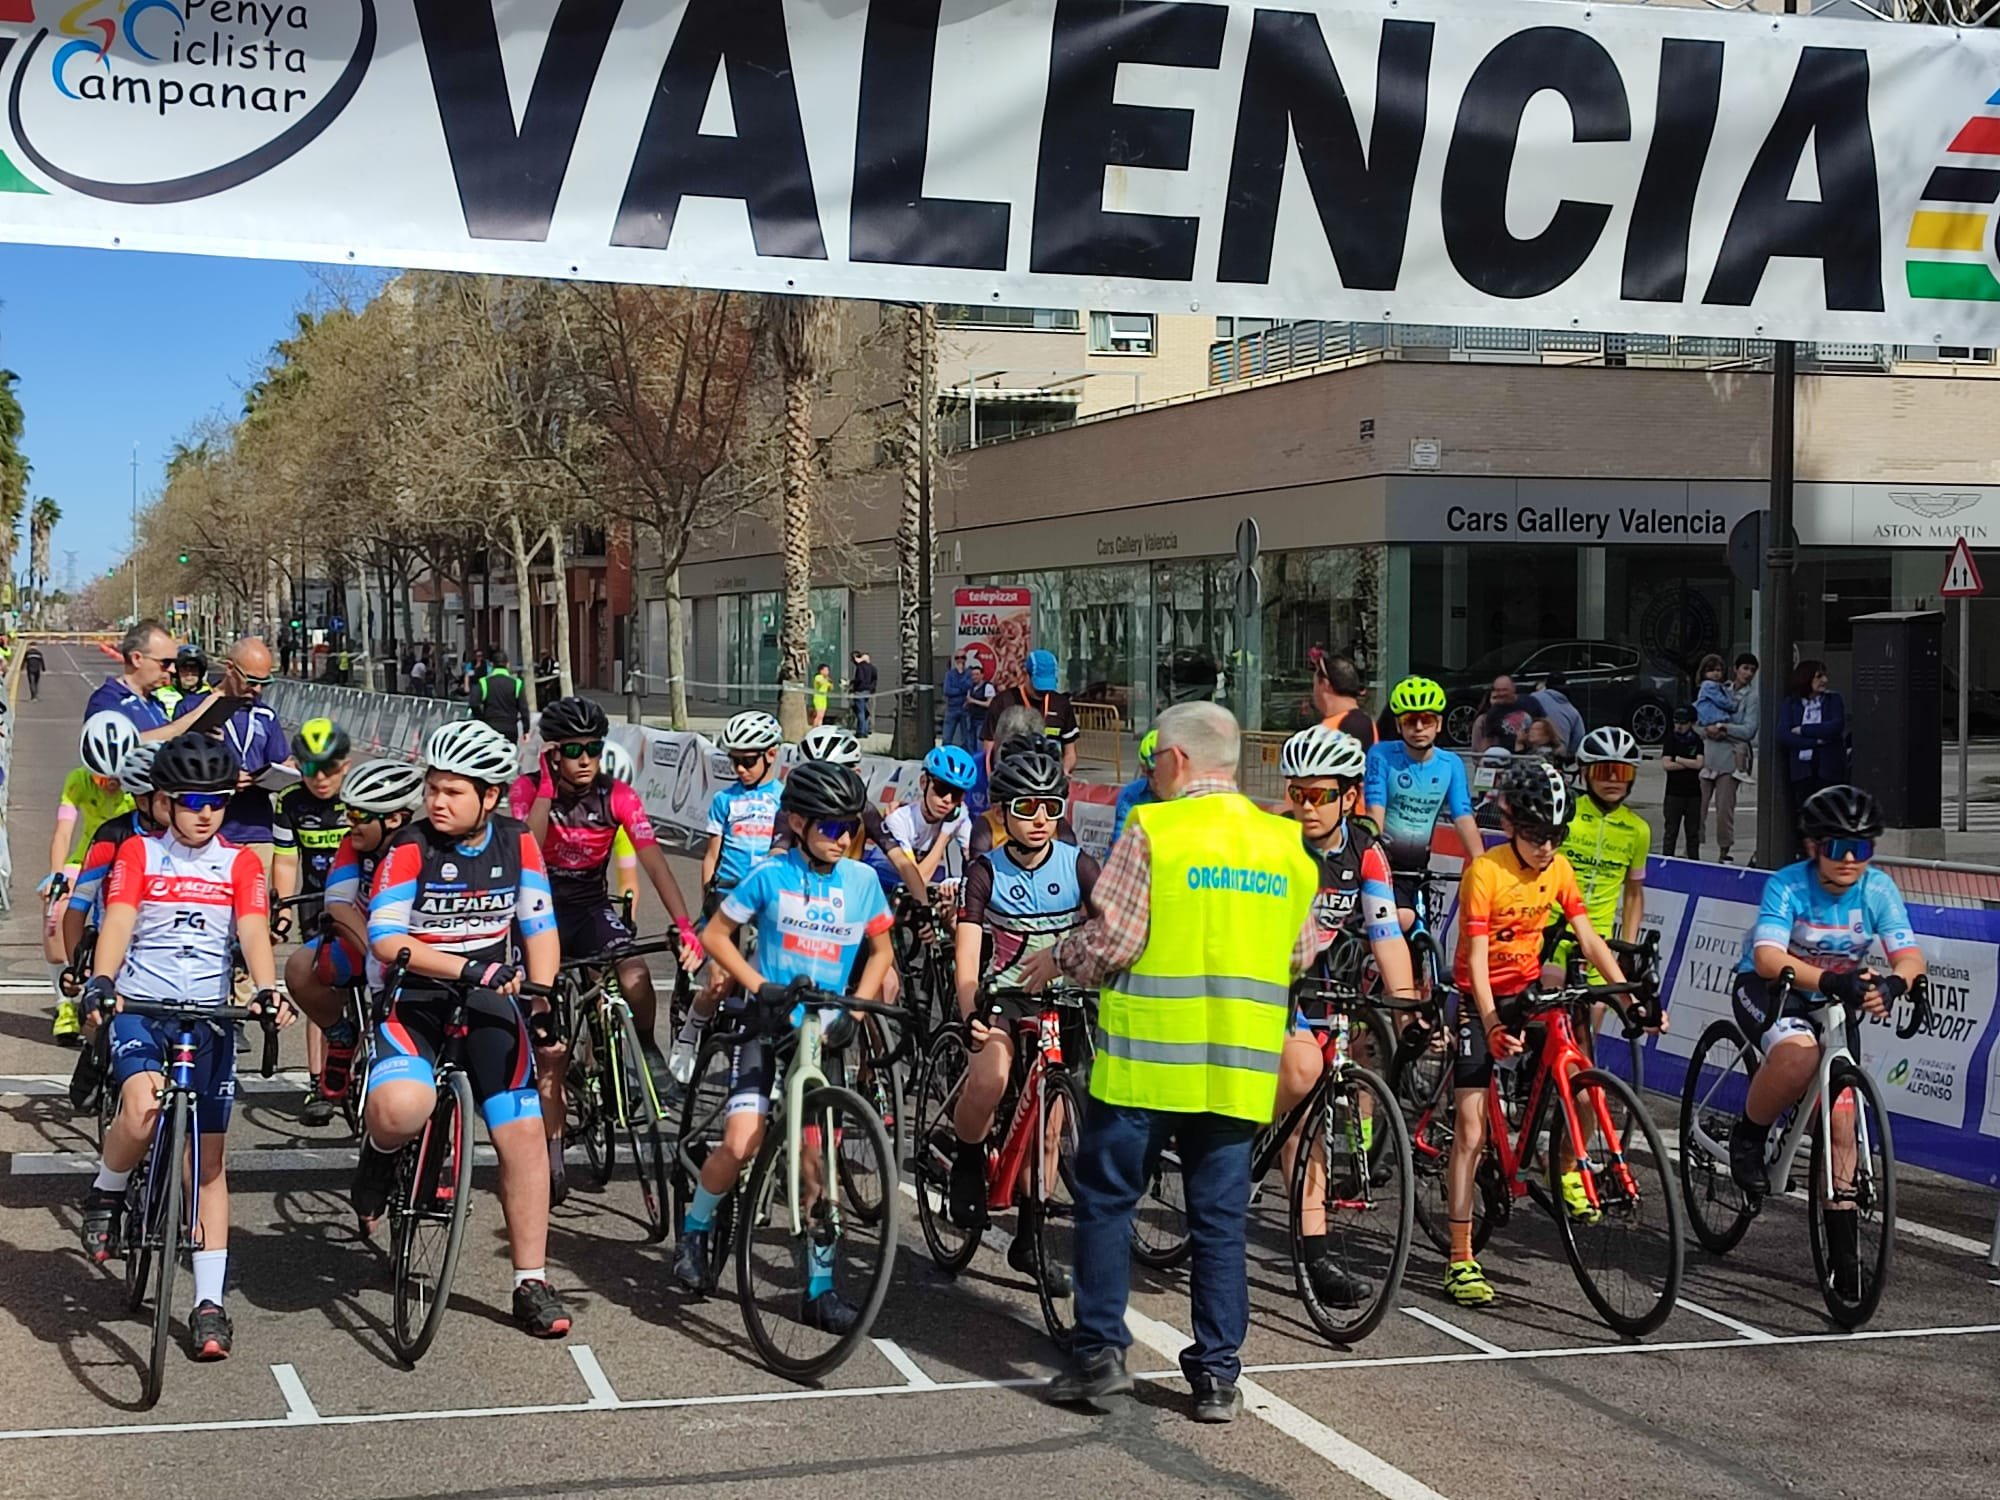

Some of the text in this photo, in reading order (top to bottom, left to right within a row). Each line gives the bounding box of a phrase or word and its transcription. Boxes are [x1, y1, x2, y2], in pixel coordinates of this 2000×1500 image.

[185, 0, 308, 36] Penya
[52, 39, 306, 115] Campanar
[414, 0, 1886, 313] VALENCIA
[1446, 506, 1726, 540] Cars Gallery Valencia
[1873, 524, 1987, 538] ASTON MARTIN
[1115, 536, 1142, 557] Gallery
[1143, 531, 1178, 553] Valencia
[968, 589, 1019, 605] telepizza
[960, 612, 998, 626] MEGA
[958, 626, 1001, 636] MEDIANA
[421, 893, 515, 913] ALFAFAR
[173, 910, 206, 930] FG
[1694, 934, 1741, 957] DIPUT
[1926, 960, 1970, 981] lenciana
[1912, 1067, 1954, 1087] TRINIDAD
[1906, 1080, 1953, 1101] ALFONSO
